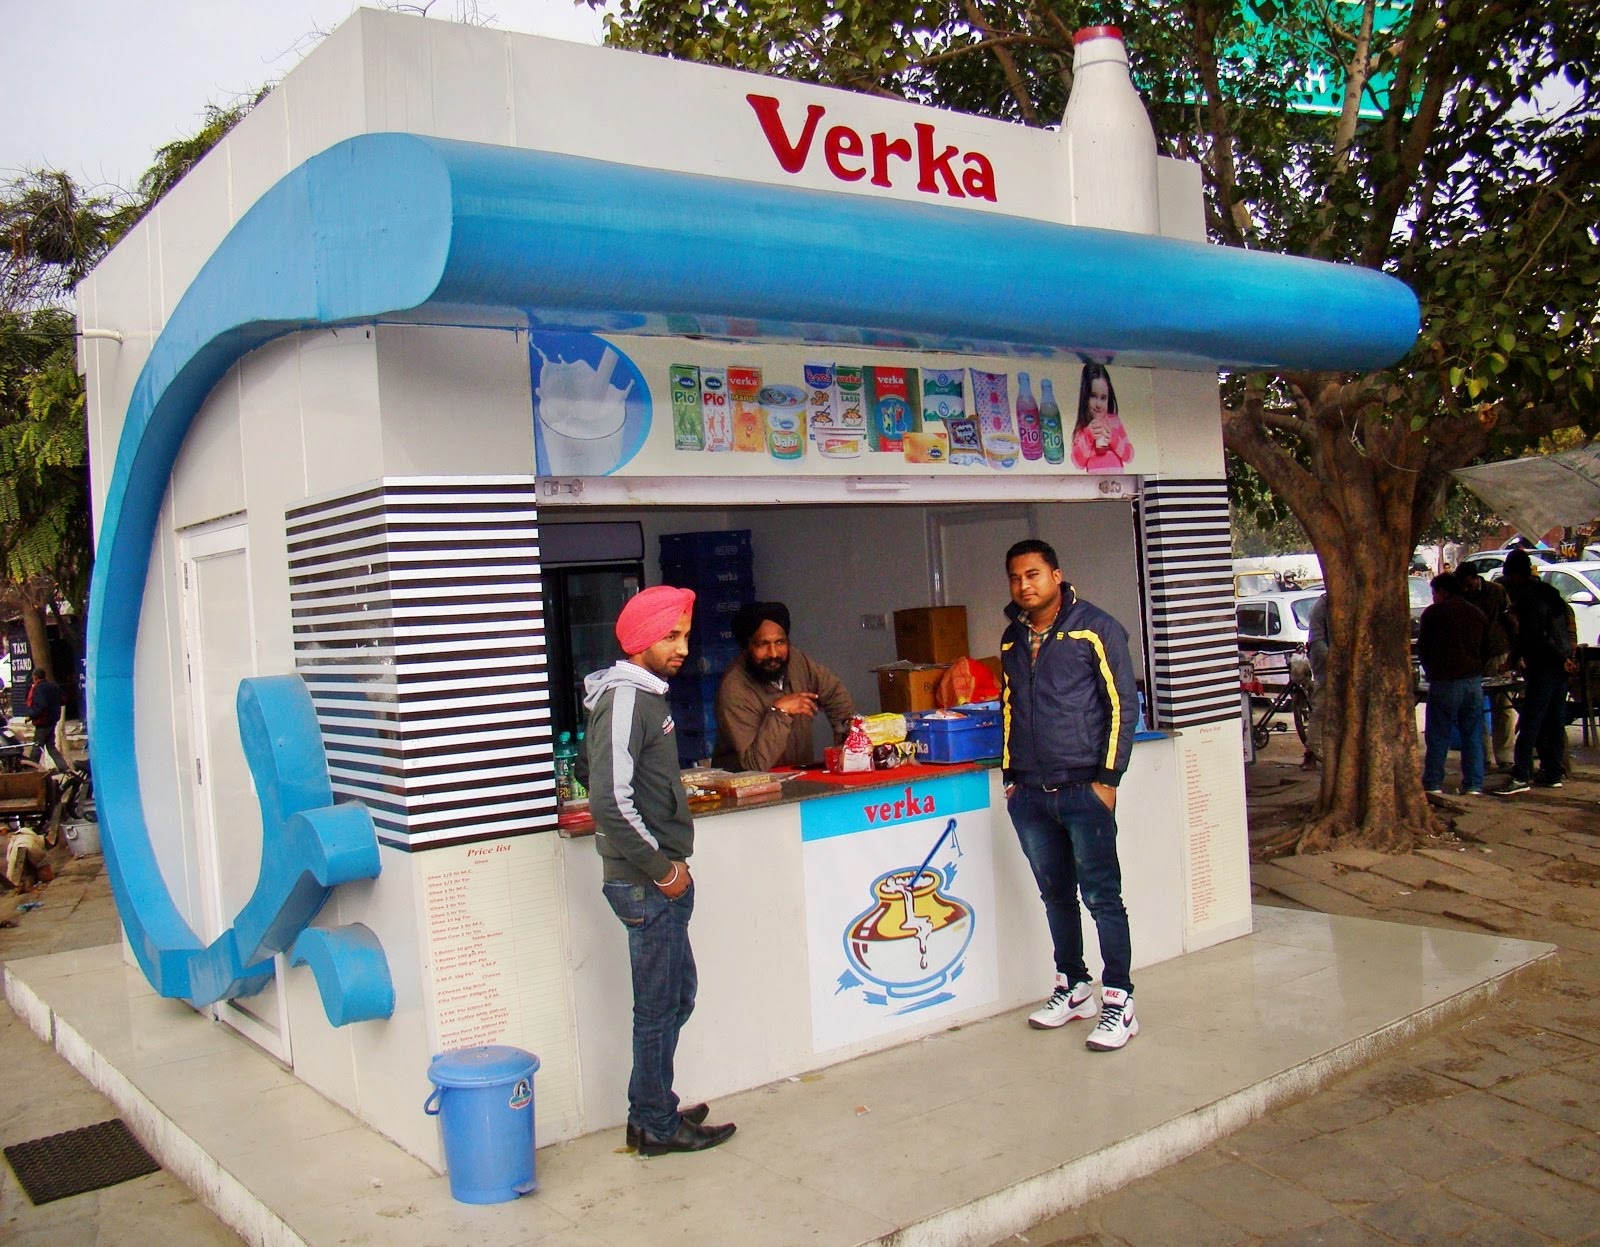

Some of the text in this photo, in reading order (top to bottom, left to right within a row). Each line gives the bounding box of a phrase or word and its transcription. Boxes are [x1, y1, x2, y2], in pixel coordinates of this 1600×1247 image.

[746, 93, 997, 202] Verka
[729, 376, 758, 386] verka
[877, 375, 904, 384] verka
[772, 433, 799, 448] Dahi
[1020, 427, 1039, 442] Pio
[1043, 431, 1062, 446] Pio
[718, 571, 738, 581] verka
[12, 642, 28, 655] TAXI
[12, 658, 32, 671] STAND
[864, 786, 935, 823] verka
[467, 844, 512, 857] Price list
[1105, 990, 1120, 998] NIKE
